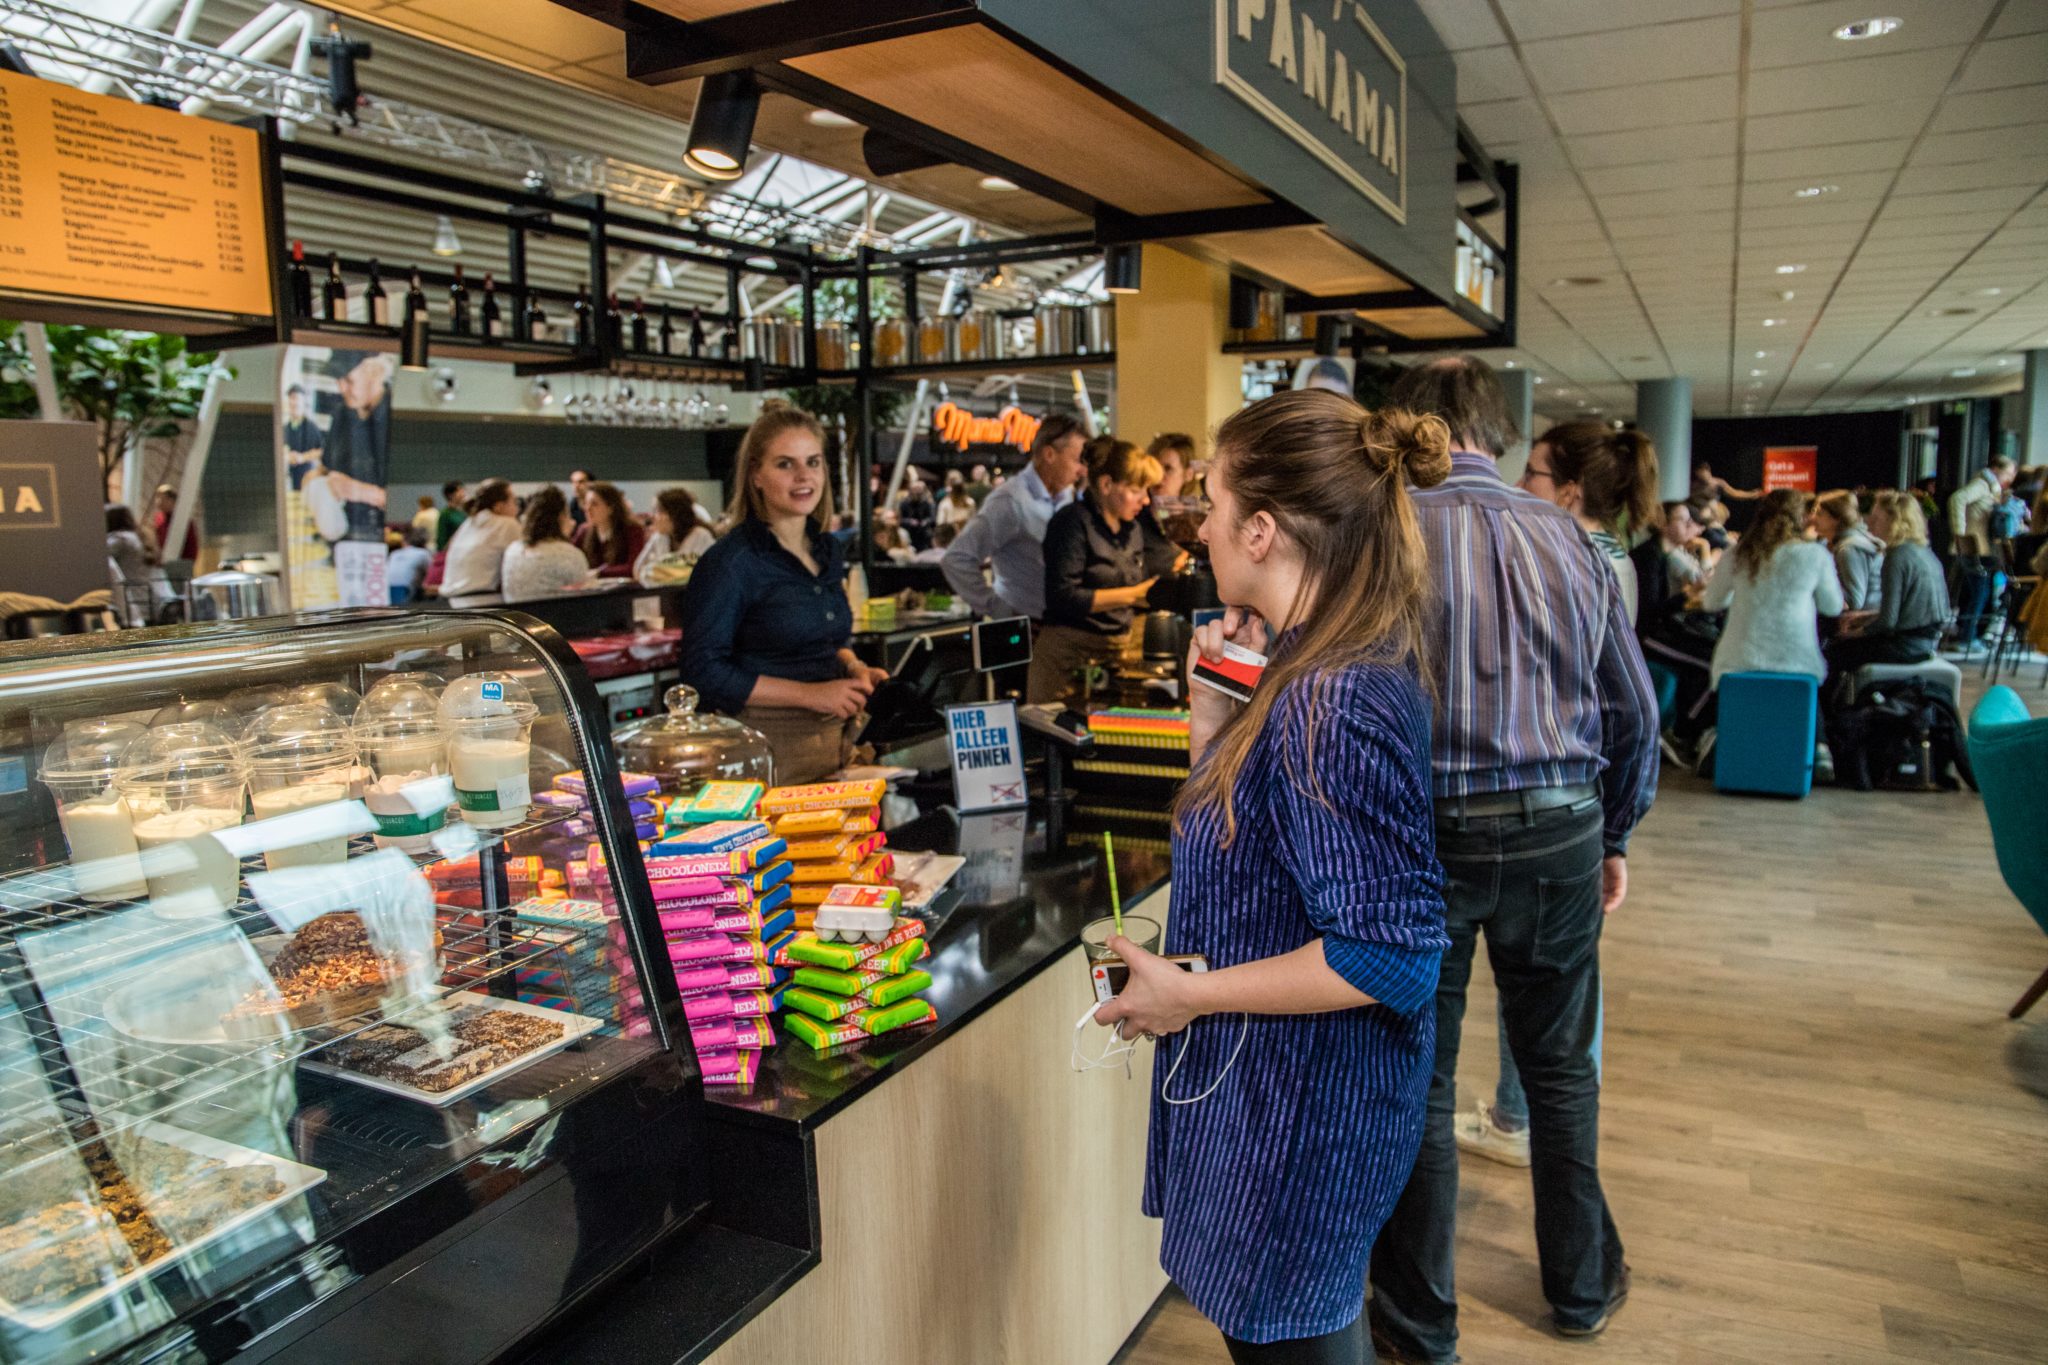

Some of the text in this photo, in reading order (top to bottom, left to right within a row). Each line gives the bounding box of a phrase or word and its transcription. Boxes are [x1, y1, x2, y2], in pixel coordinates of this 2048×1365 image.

[0, 486, 43, 513] A
[952, 709, 987, 730] HIER
[955, 727, 1009, 750] ALLEEN
[957, 746, 1012, 770] PINNEN
